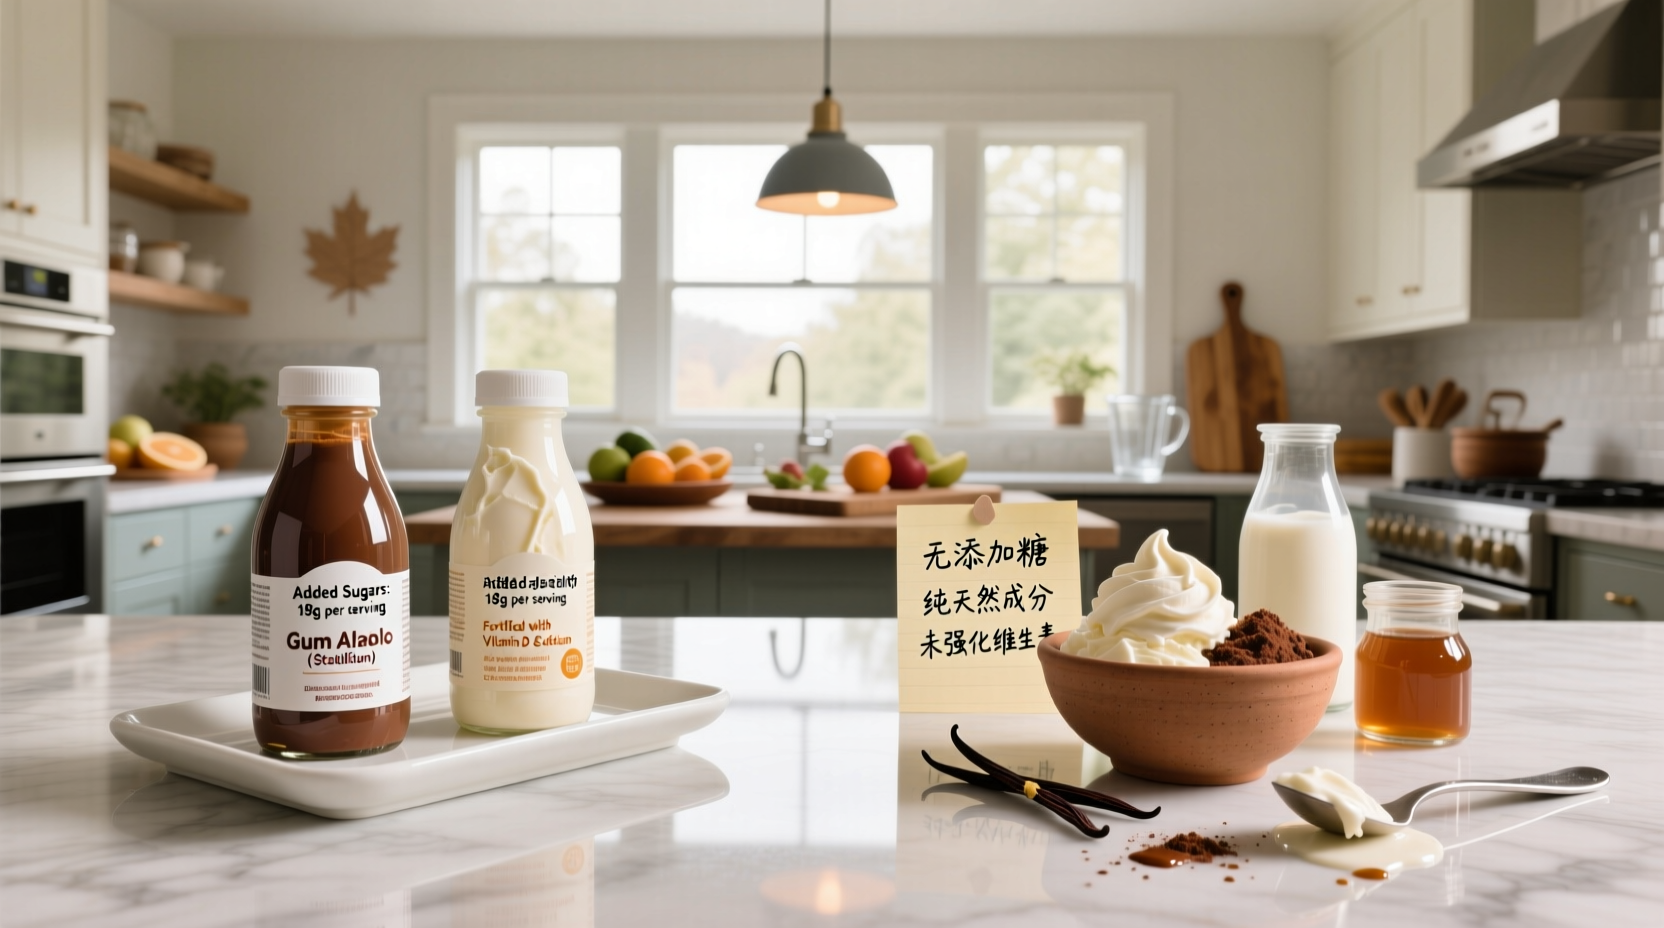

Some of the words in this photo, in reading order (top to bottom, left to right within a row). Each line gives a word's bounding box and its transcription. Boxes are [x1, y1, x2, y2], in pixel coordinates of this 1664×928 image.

[923, 533, 1049, 570] 无添加糖
[292, 584, 338, 600] Added
[342, 584, 390, 601] Sugars:
[511, 596, 529, 608] per
[532, 593, 567, 606] serving
[923, 583, 1053, 616] 纯天然成分
[325, 606, 344, 619] per
[286, 631, 332, 650] Gum
[521, 635, 530, 647] D
